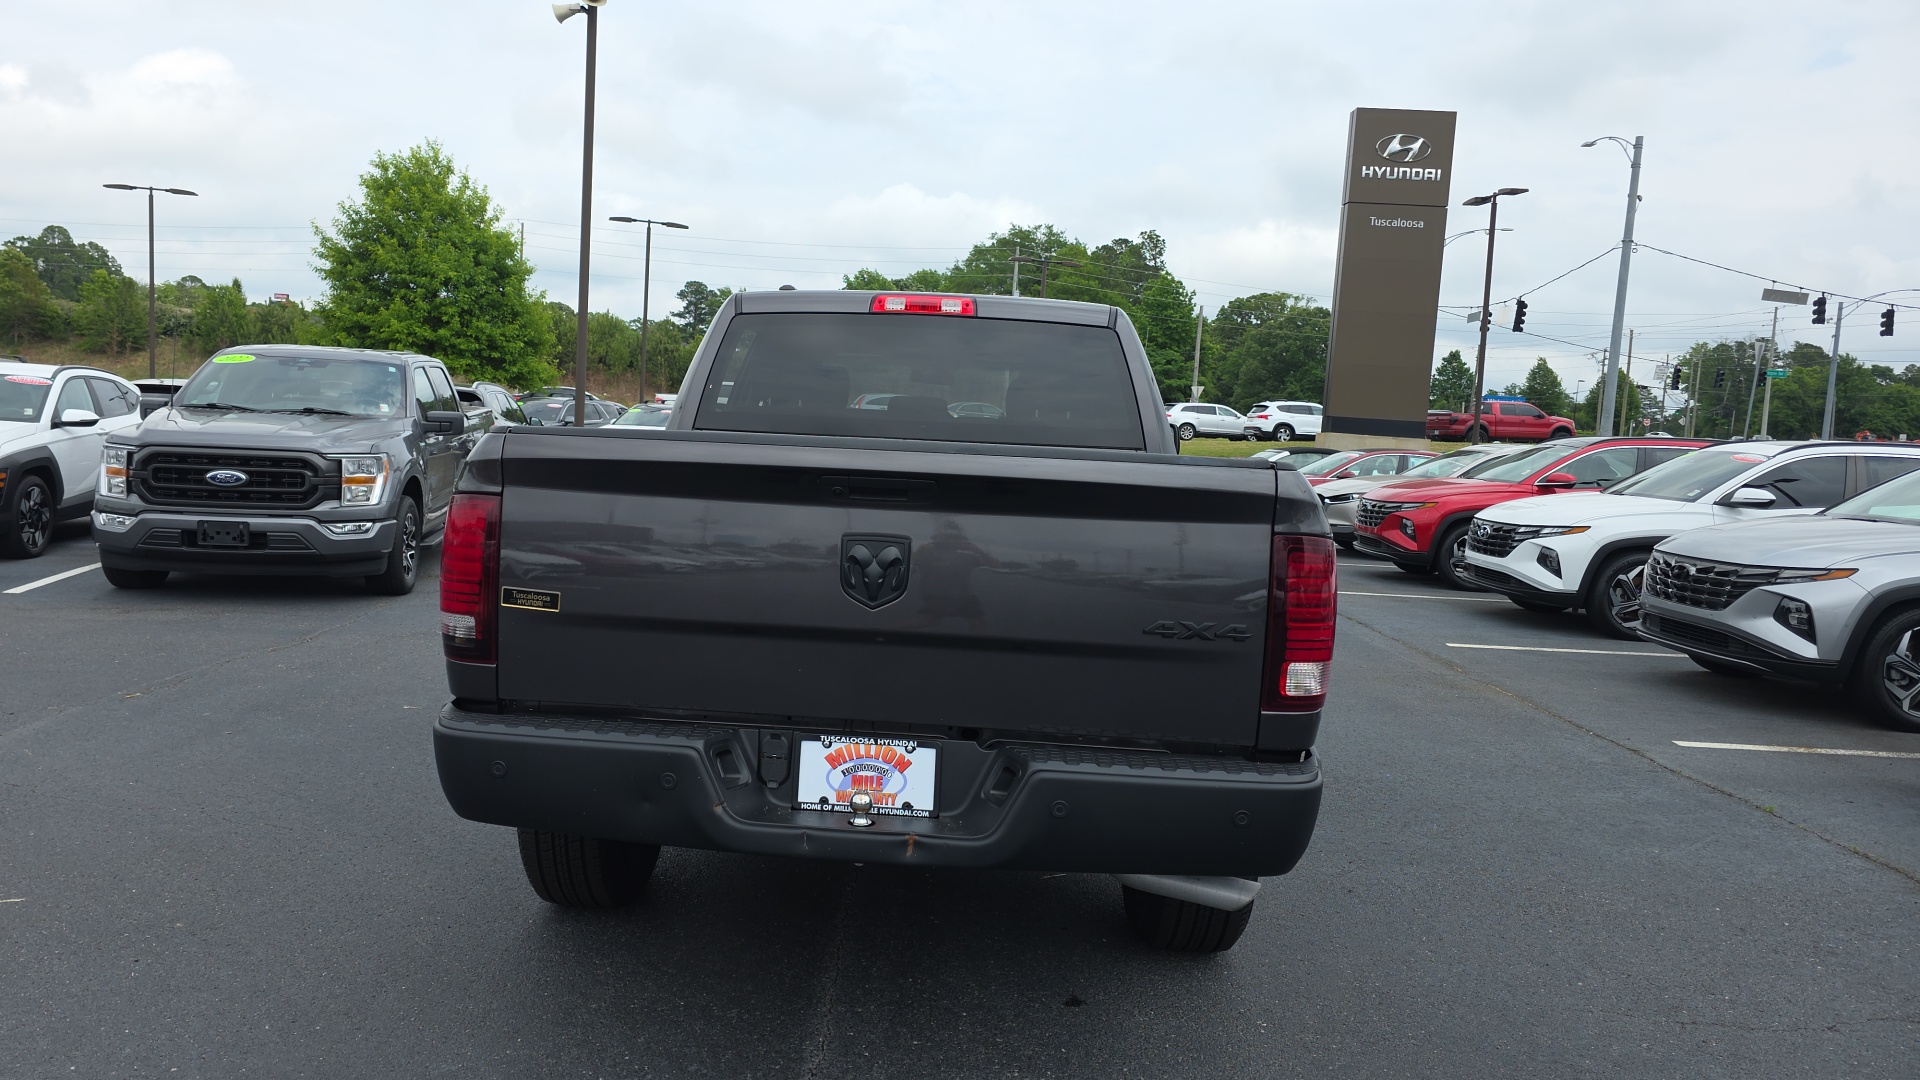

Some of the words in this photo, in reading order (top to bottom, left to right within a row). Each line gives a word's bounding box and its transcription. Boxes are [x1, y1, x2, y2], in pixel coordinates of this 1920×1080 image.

[1361, 165, 1442, 181] HYUNDAI
[1369, 216, 1425, 228] Tuscaloosa
[215, 473, 237, 483] Ford
[512, 591, 550, 601] Tuscaloosa
[820, 735, 875, 745] TUSCALOOSA
[877, 738, 917, 748] HYUNDAI
[824, 743, 912, 774] MILLION
[851, 773, 884, 792] MILE
[835, 789, 898, 807] WAANTY
[801, 803, 821, 811] HOME
